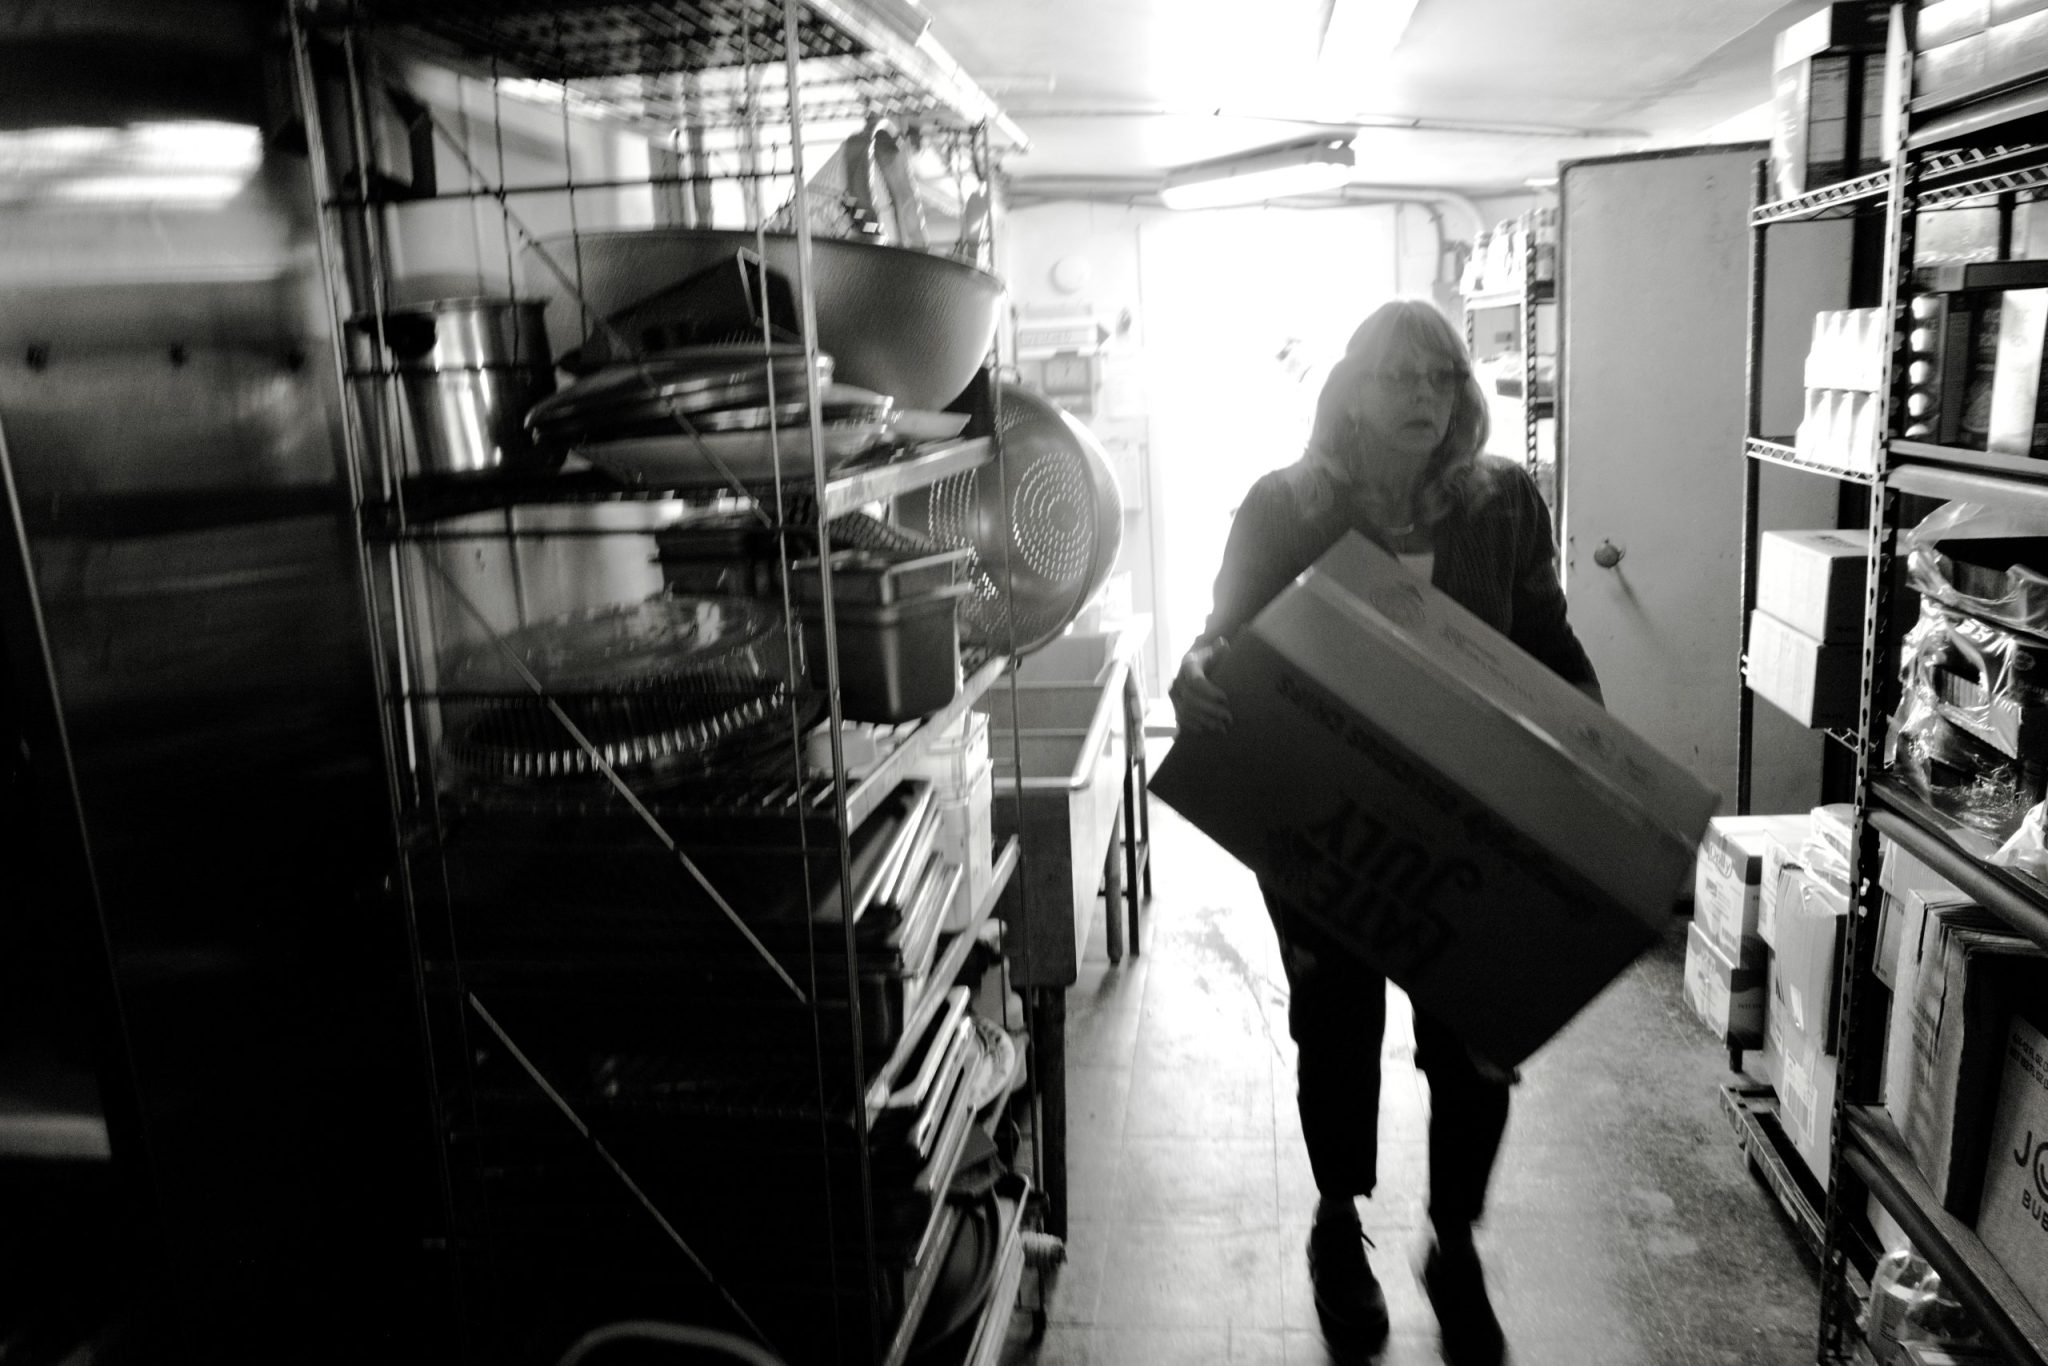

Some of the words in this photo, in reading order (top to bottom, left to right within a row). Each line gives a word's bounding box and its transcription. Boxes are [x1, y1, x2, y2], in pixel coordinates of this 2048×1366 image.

[1273, 670, 1347, 734] CHIPS
[1306, 798, 1482, 912] JULY
[1304, 861, 1459, 982] LATE
